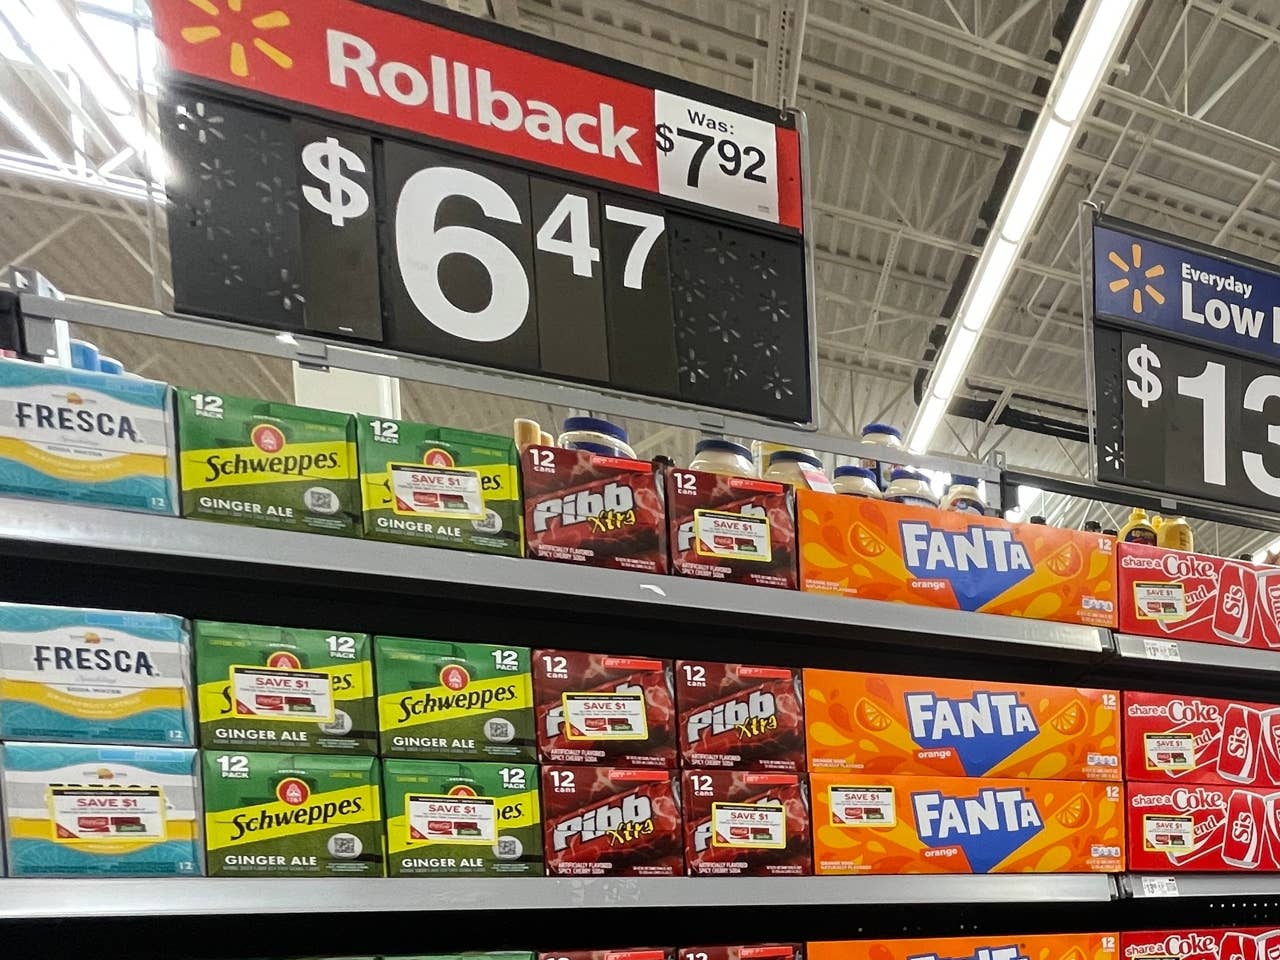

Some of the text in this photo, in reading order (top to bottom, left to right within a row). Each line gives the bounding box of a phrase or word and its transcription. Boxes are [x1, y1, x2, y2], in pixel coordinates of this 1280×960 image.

[326, 29, 642, 166] Rollback
[687, 108, 734, 135] Was:
[1181, 263, 1252, 298] Everyday
[1181, 283, 1264, 338] Low
[191, 393, 224, 412] 12
[16, 402, 138, 442] FRESCA
[196, 409, 223, 419] PACK
[369, 420, 399, 437] 12
[374, 435, 398, 445] PACK
[206, 450, 338, 481] Schweppes
[530, 449, 554, 468] 12
[411, 473, 461, 487] SAVE $1
[673, 472, 696, 490] 12
[199, 496, 262, 515] GINGER
[266, 505, 293, 518] ALE
[534, 483, 634, 532] Pibb
[377, 517, 461, 536] GINGER ALE
[713, 519, 752, 531] SAVE $1
[901, 523, 1031, 572] FANTA
[1098, 538, 1112, 550] 12
[1122, 557, 1154, 568] share
[1162, 554, 1216, 578] Coke
[912, 580, 945, 590] orange
[1225, 585, 1244, 618] Sis
[326, 636, 355, 653] 12
[34, 645, 154, 676] FRESCA
[255, 677, 309, 689] SAVE $1
[399, 684, 517, 722] Schweppes
[1168, 701, 1220, 723] Coke
[687, 693, 774, 742] Pibb
[908, 693, 1036, 740] FANTA
[215, 728, 307, 741] GINGER ALE
[393, 736, 475, 749] GINGER ALE
[1231, 727, 1247, 758] Sis
[217, 756, 249, 772] 12
[918, 749, 951, 760] orange
[222, 769, 248, 778] PACK
[77, 798, 138, 808] SAVE $1
[916, 788, 1042, 837] FANTA
[231, 796, 363, 840] Schweppes
[555, 792, 652, 850] Pibb
[224, 855, 317, 866] GINGER ALE
[1163, 935, 1216, 957] Coke
